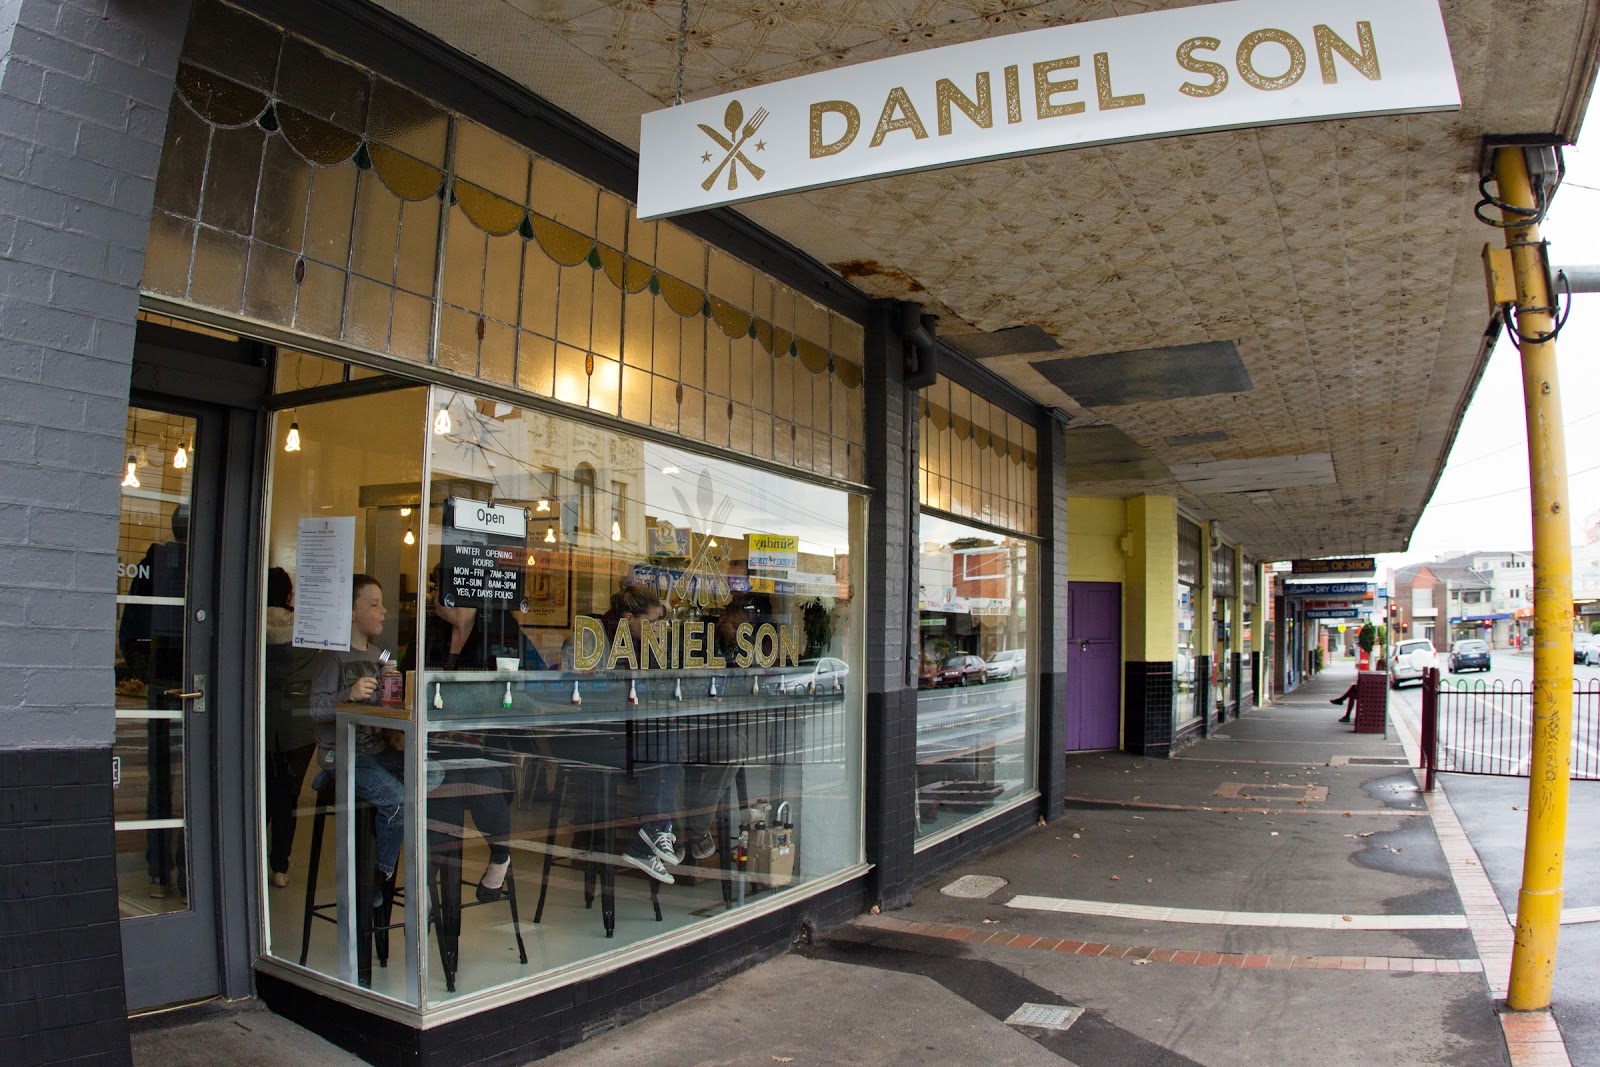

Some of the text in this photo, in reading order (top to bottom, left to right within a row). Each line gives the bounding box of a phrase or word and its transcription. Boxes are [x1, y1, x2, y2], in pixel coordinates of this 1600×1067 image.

[809, 20, 1382, 159] DANIEL SON
[477, 508, 505, 525] Open
[455, 545, 480, 556] WINTER
[485, 549, 513, 560] OPENING
[472, 558, 494, 568] HOURS
[1331, 560, 1372, 570] OP SHOP
[117, 562, 150, 580] SON
[489, 569, 516, 580] 7AM-3PM
[453, 577, 516, 590] SAT-SUN 8AM-3PM
[1315, 585, 1330, 593] DRY
[1331, 584, 1366, 593] CLEANING
[477, 589, 493, 598] DAYS
[494, 590, 513, 600] FOLKS
[573, 615, 799, 670] DANIEL SON
